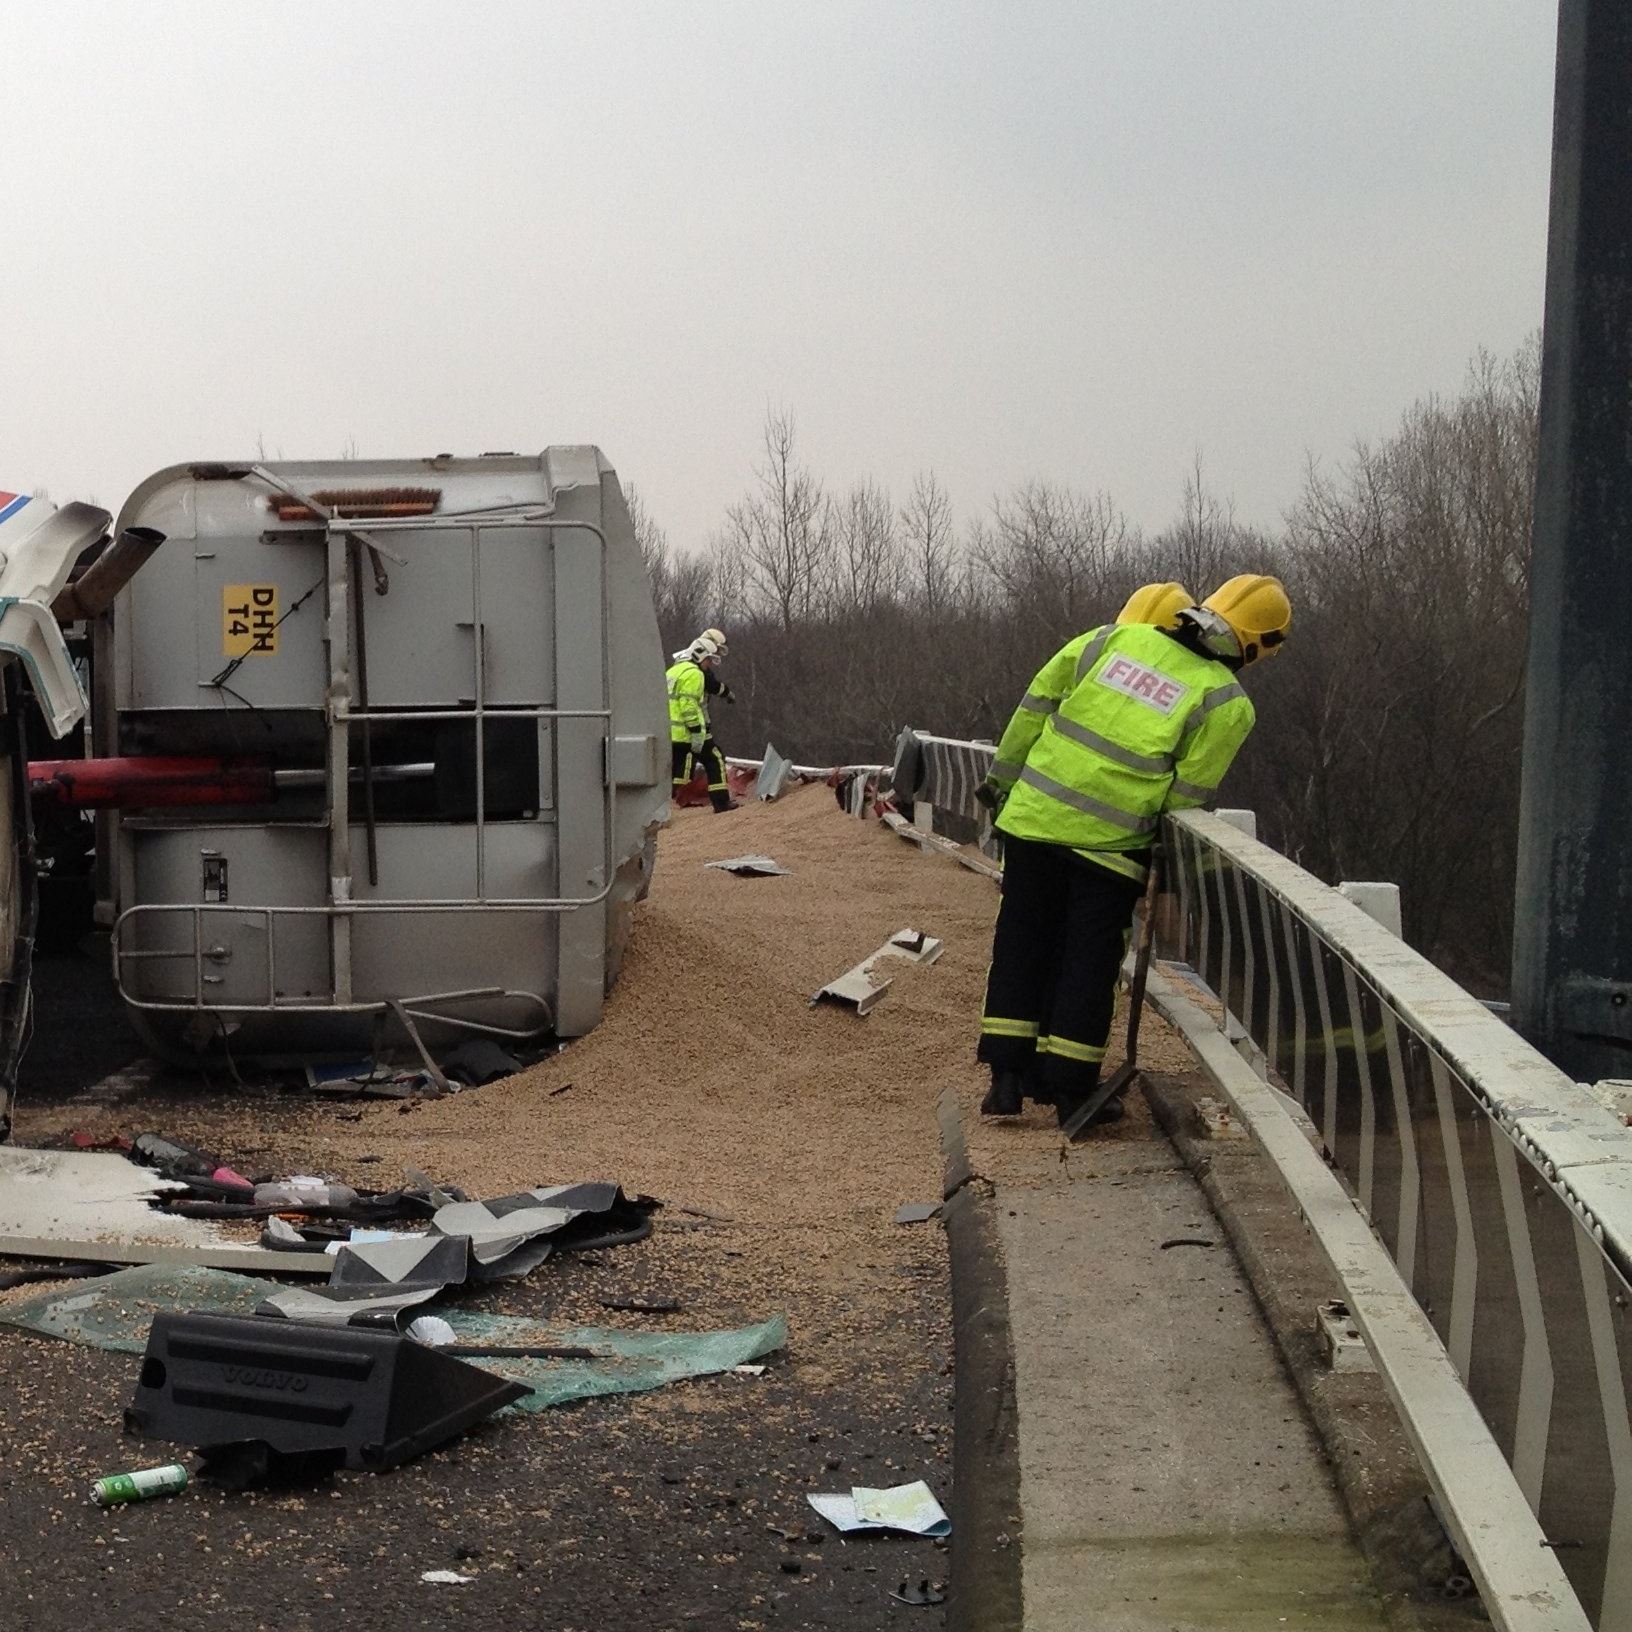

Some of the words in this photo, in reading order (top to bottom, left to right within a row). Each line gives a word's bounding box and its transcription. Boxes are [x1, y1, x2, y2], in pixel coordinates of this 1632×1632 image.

[228, 603, 249, 636] T4
[252, 588, 274, 651] DHH
[1105, 660, 1181, 707] FIRE
[223, 1365, 309, 1393] VOLVO
